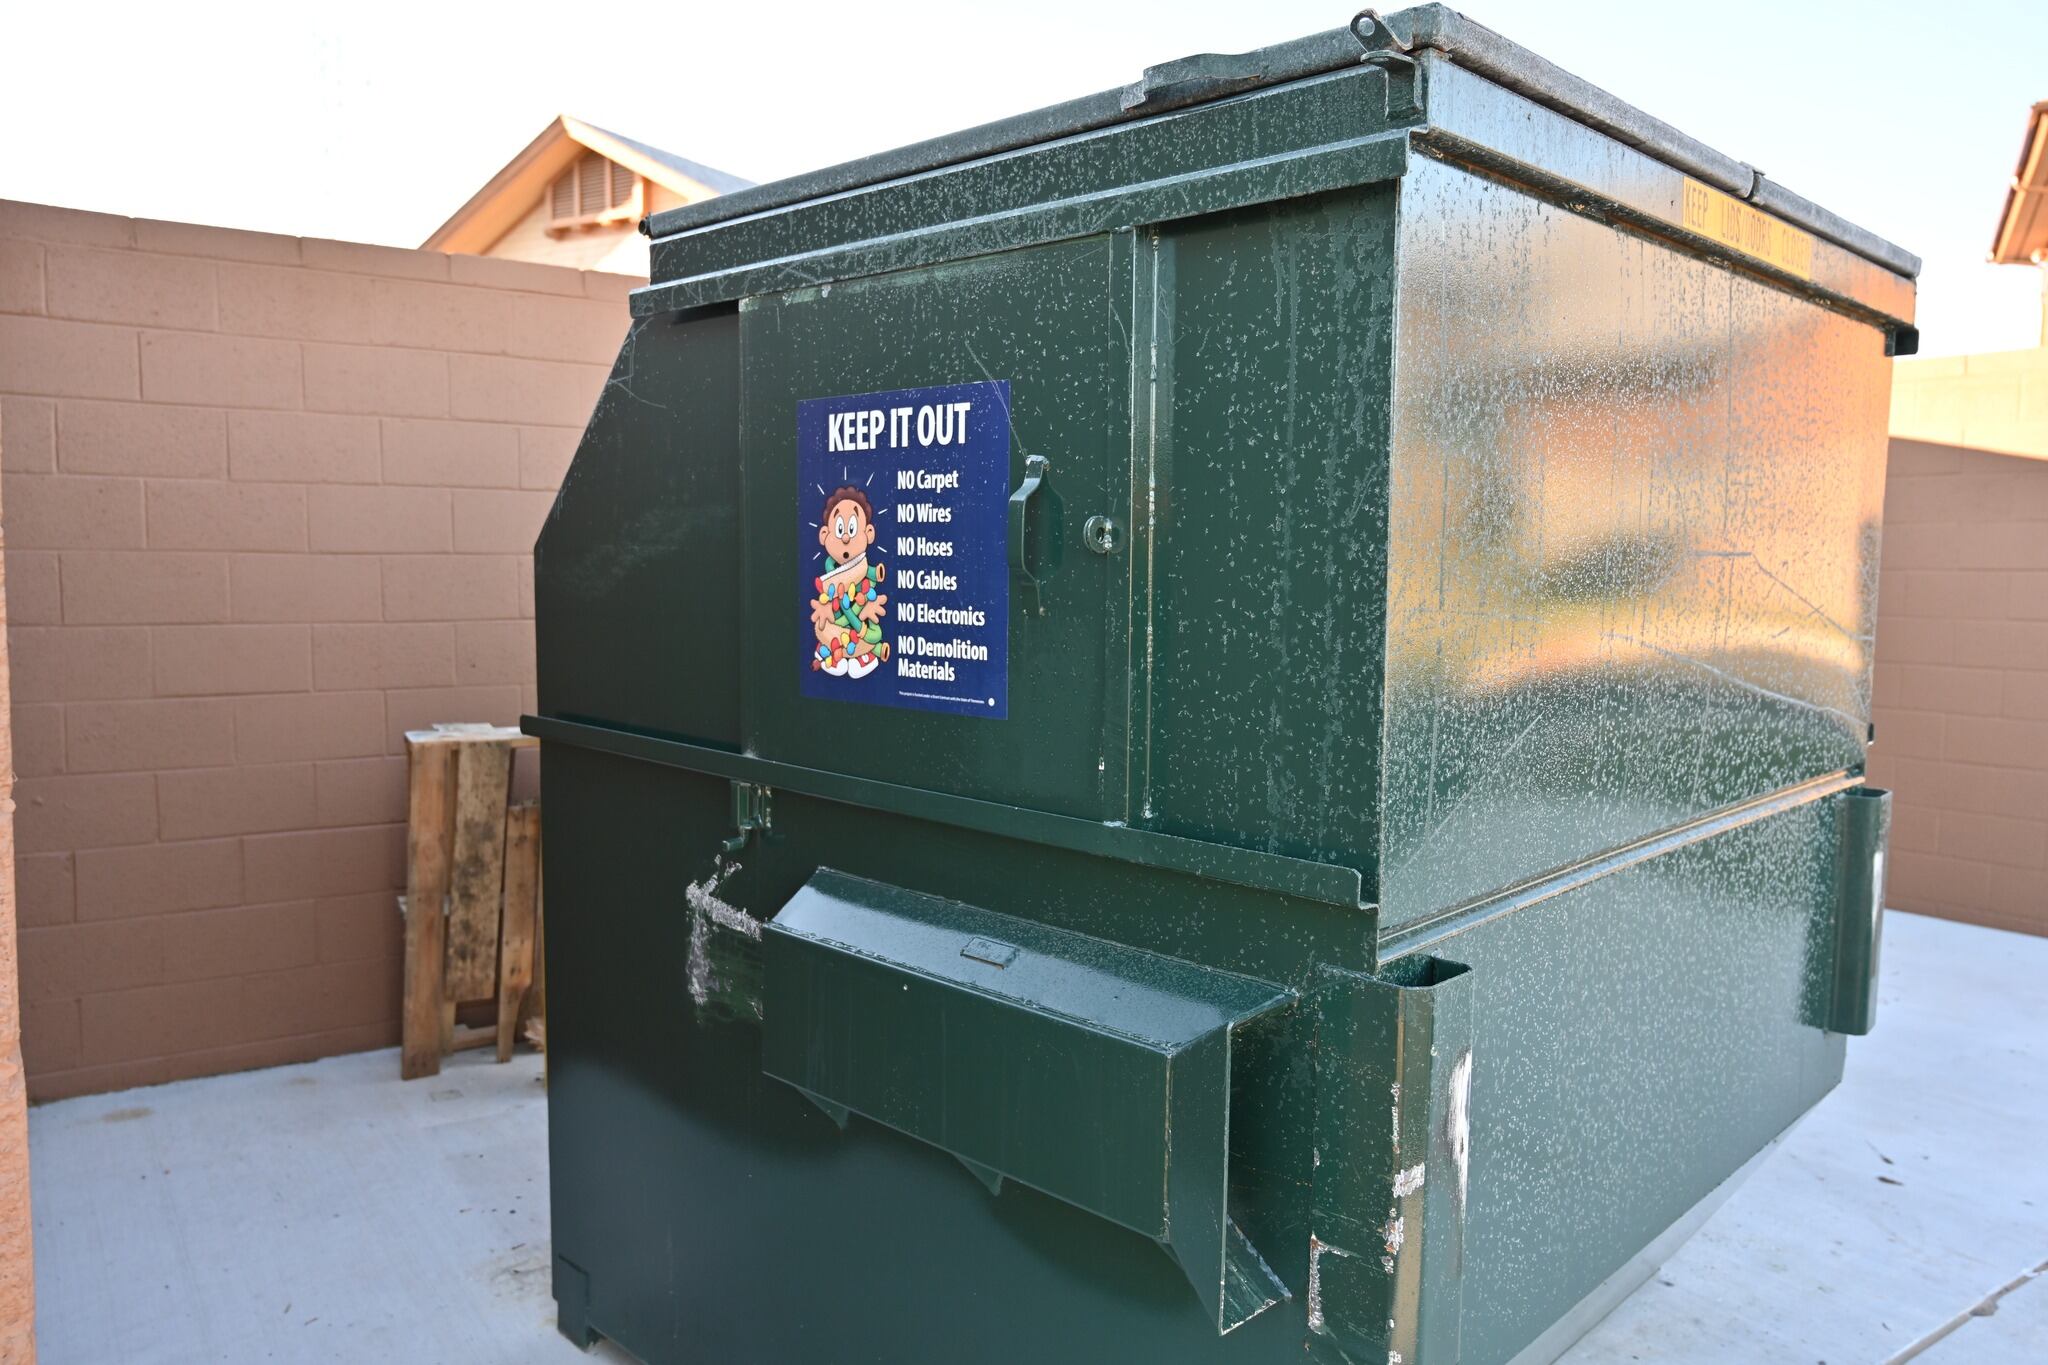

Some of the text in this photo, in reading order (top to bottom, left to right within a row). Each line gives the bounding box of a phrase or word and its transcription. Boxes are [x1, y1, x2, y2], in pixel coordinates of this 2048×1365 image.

[1685, 182, 1708, 230] KEEP
[828, 402, 971, 452] KEEP IT OUT
[897, 469, 959, 493] NO Carpet
[897, 503, 952, 523] NO Wires
[897, 537, 953, 557] NO Hoses
[897, 570, 957, 591] NO Cables
[897, 603, 986, 626] NO Electronics
[897, 636, 988, 661] NO Demolition
[897, 658, 956, 682] Materials
